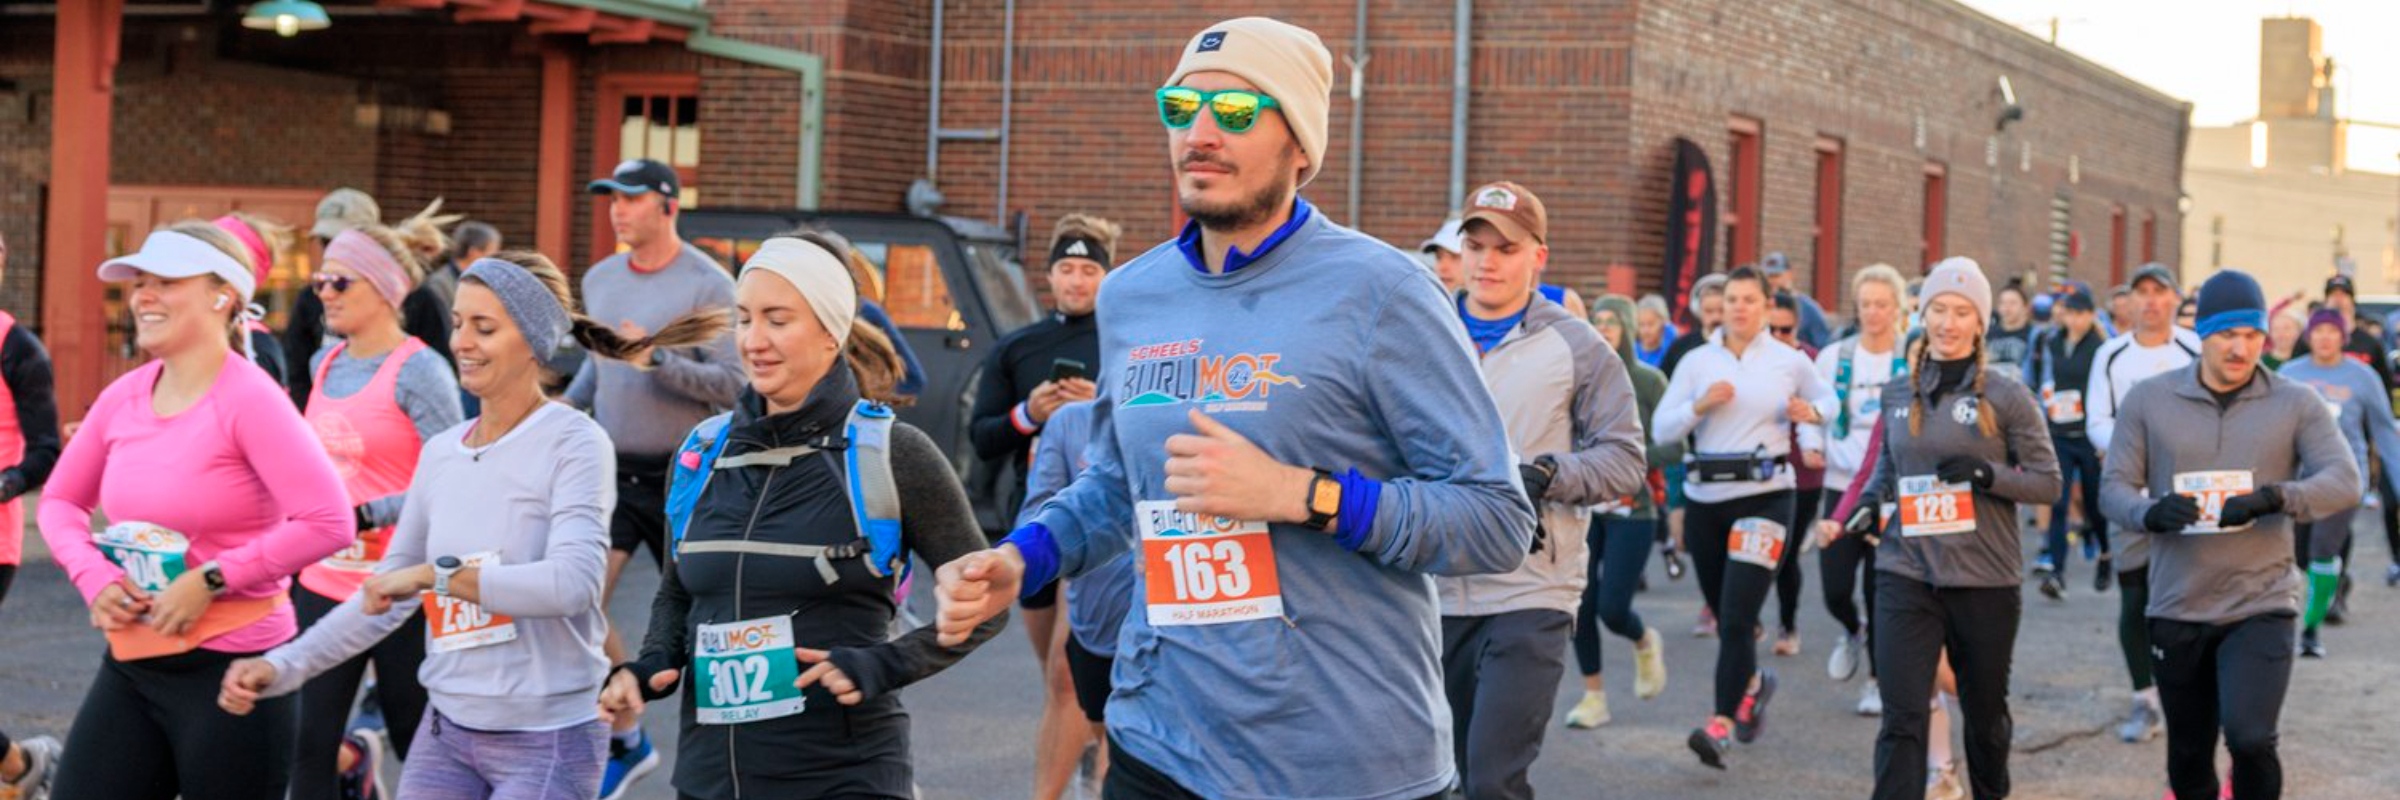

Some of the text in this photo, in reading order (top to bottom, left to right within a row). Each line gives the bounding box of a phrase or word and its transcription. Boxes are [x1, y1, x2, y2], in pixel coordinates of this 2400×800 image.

[1129, 339, 1200, 361] SCHEELS
[1913, 494, 1959, 523] 128
[1164, 540, 1251, 601] 163
[708, 654, 773, 706] 302
[721, 707, 759, 720] RELAY
